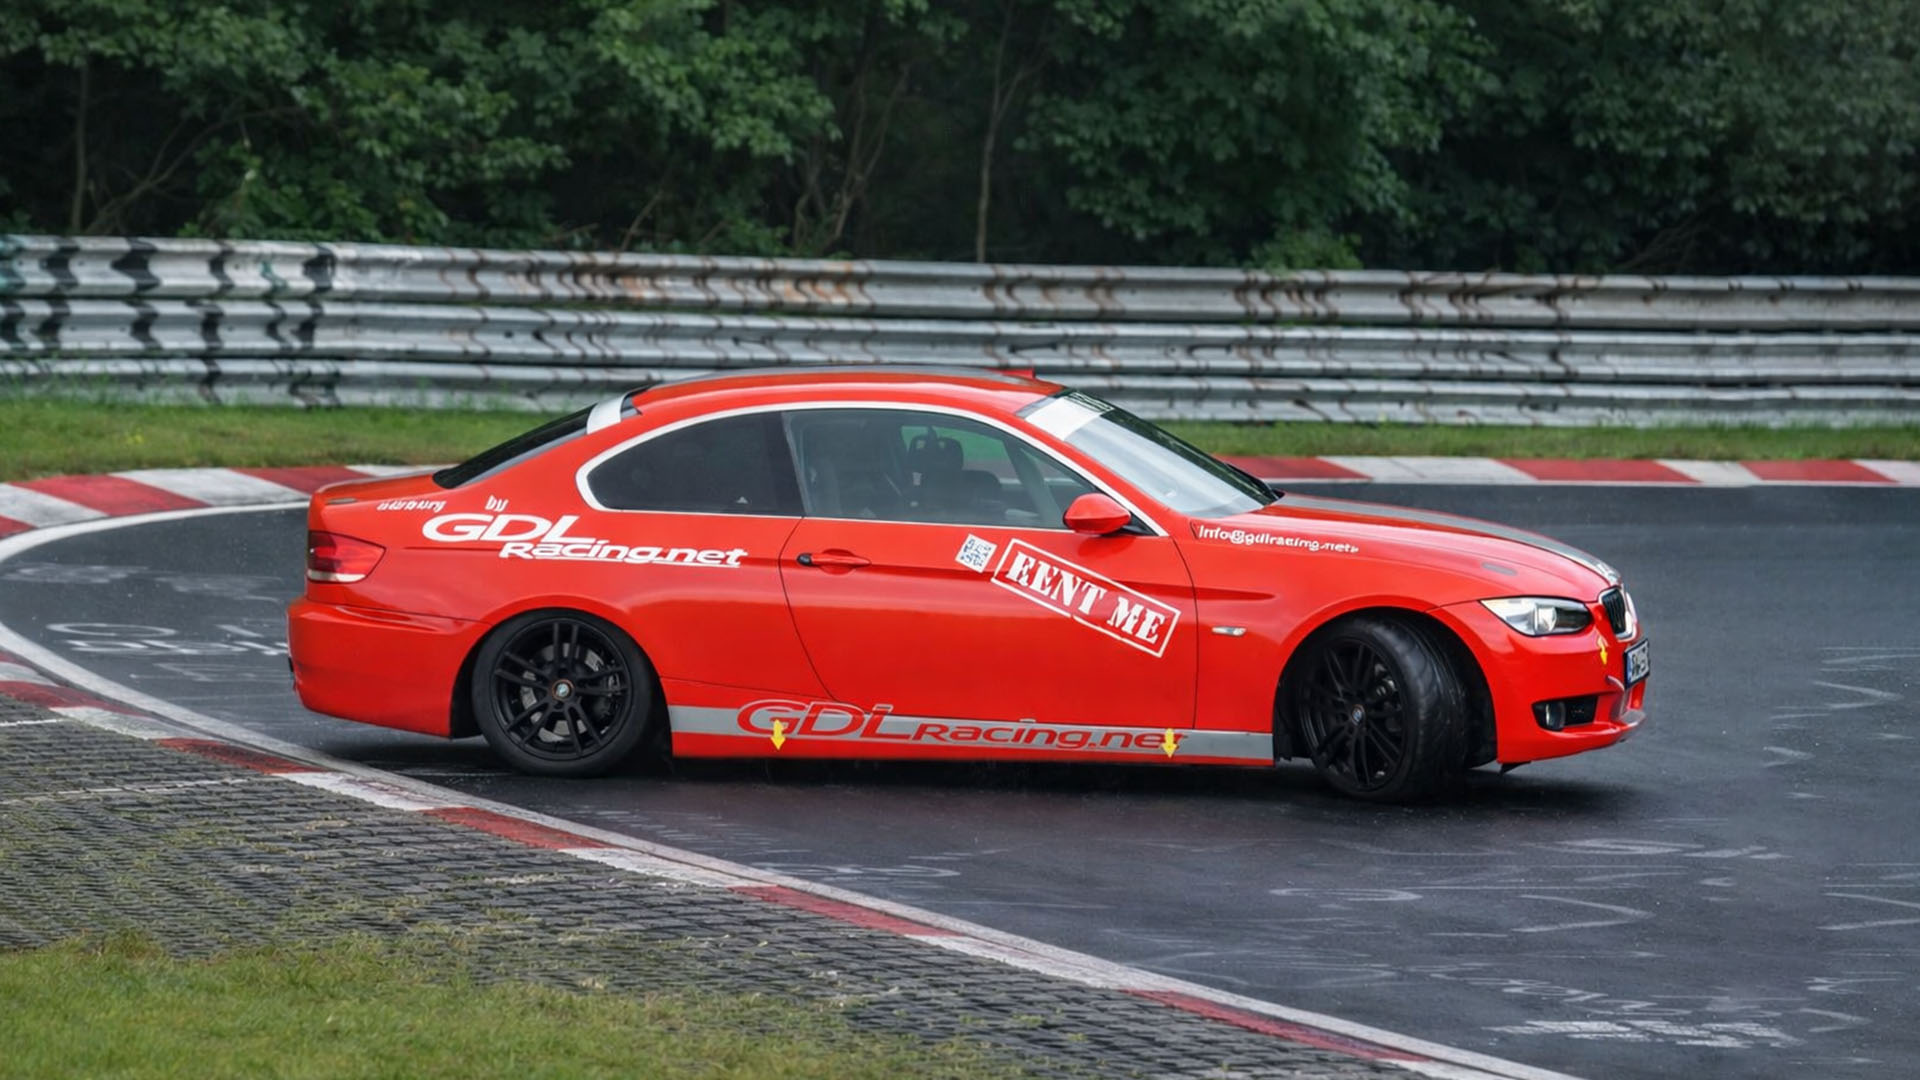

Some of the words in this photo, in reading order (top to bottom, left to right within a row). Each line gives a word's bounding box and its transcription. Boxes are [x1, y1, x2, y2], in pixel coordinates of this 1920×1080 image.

[485, 494, 509, 512] by
[422, 513, 594, 543] GDL
[499, 540, 748, 568] Racing.net
[1006, 551, 1107, 615] RENT
[1106, 596, 1166, 644] ME
